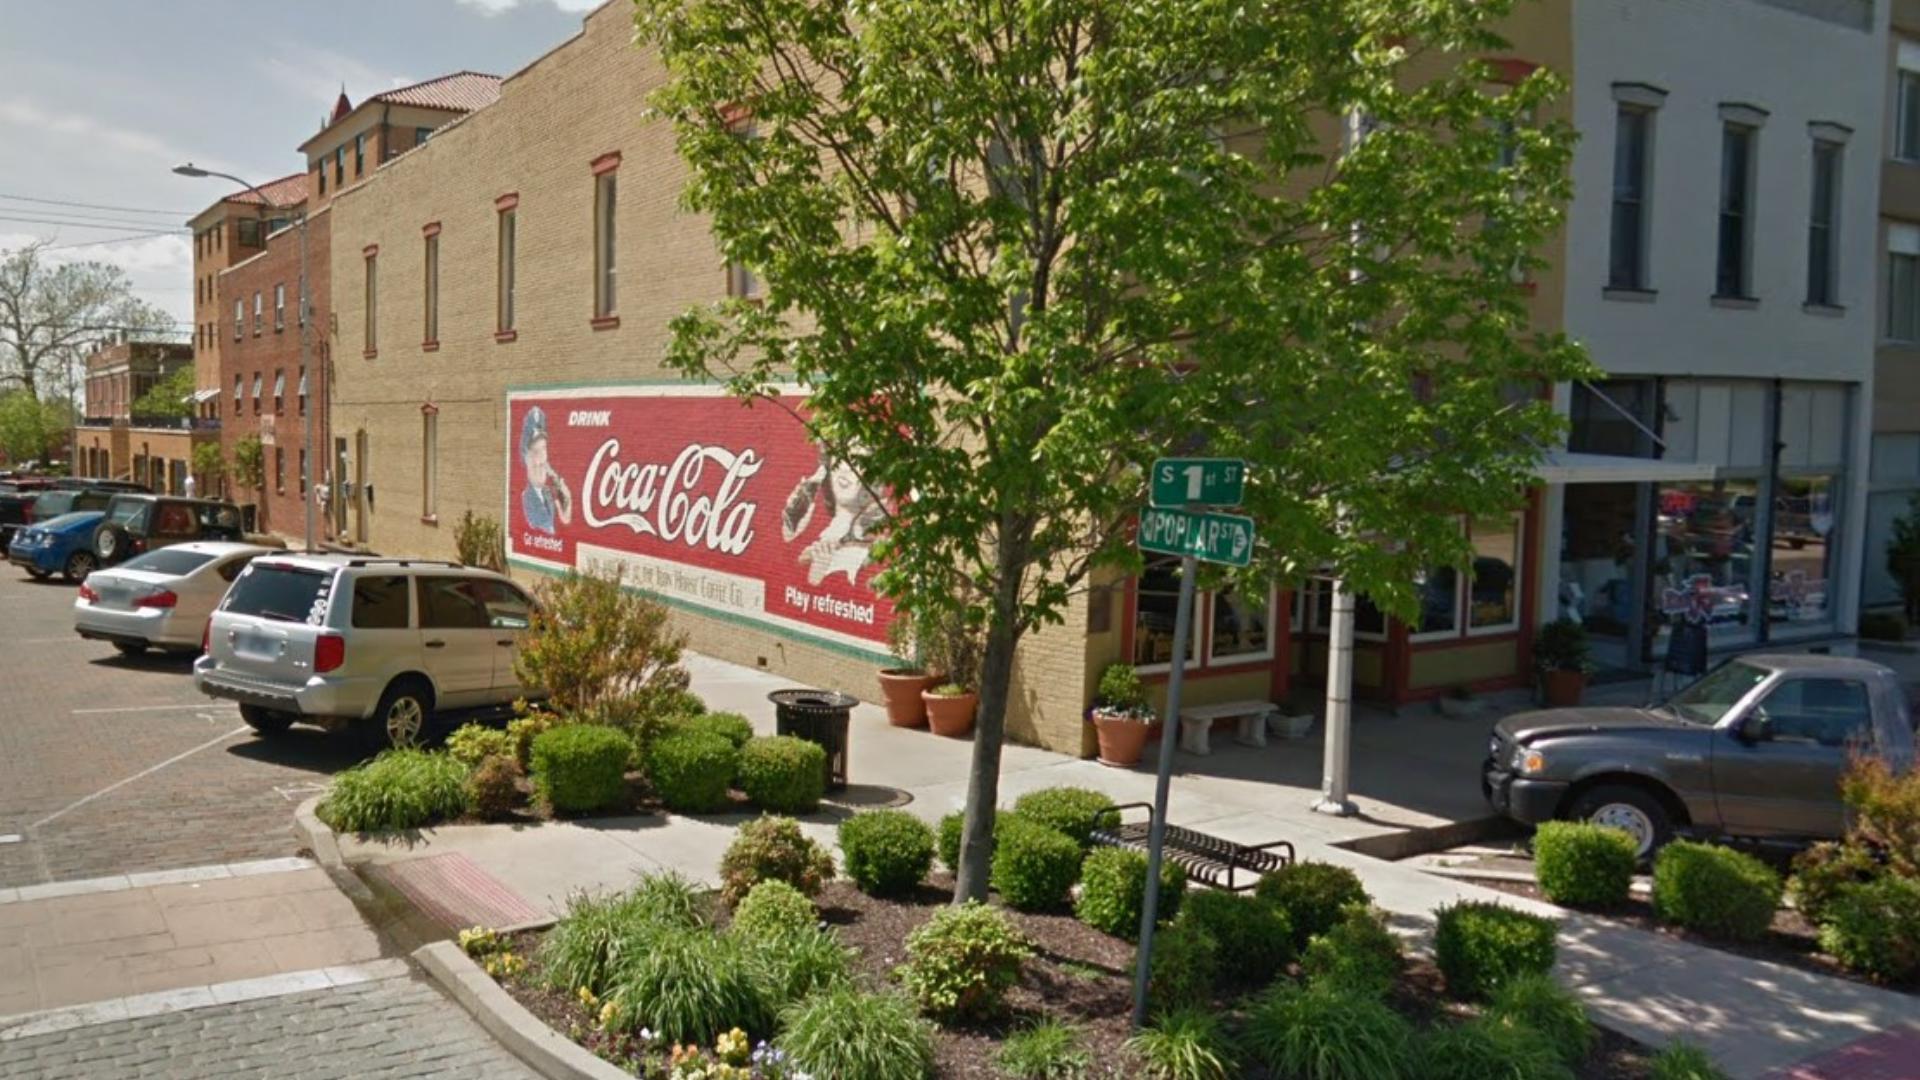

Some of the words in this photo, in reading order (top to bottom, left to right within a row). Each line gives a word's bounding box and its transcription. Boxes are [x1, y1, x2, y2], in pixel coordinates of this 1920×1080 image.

[568, 410, 612, 427] DRINK
[1161, 465, 1175, 483] S
[1223, 466, 1238, 483] ST
[582, 438, 764, 556] Coca-Cola
[1152, 511, 1221, 555] POPLAR
[1221, 522, 1234, 539] ST
[784, 585, 810, 613] Play
[812, 593, 874, 625] refreshed
